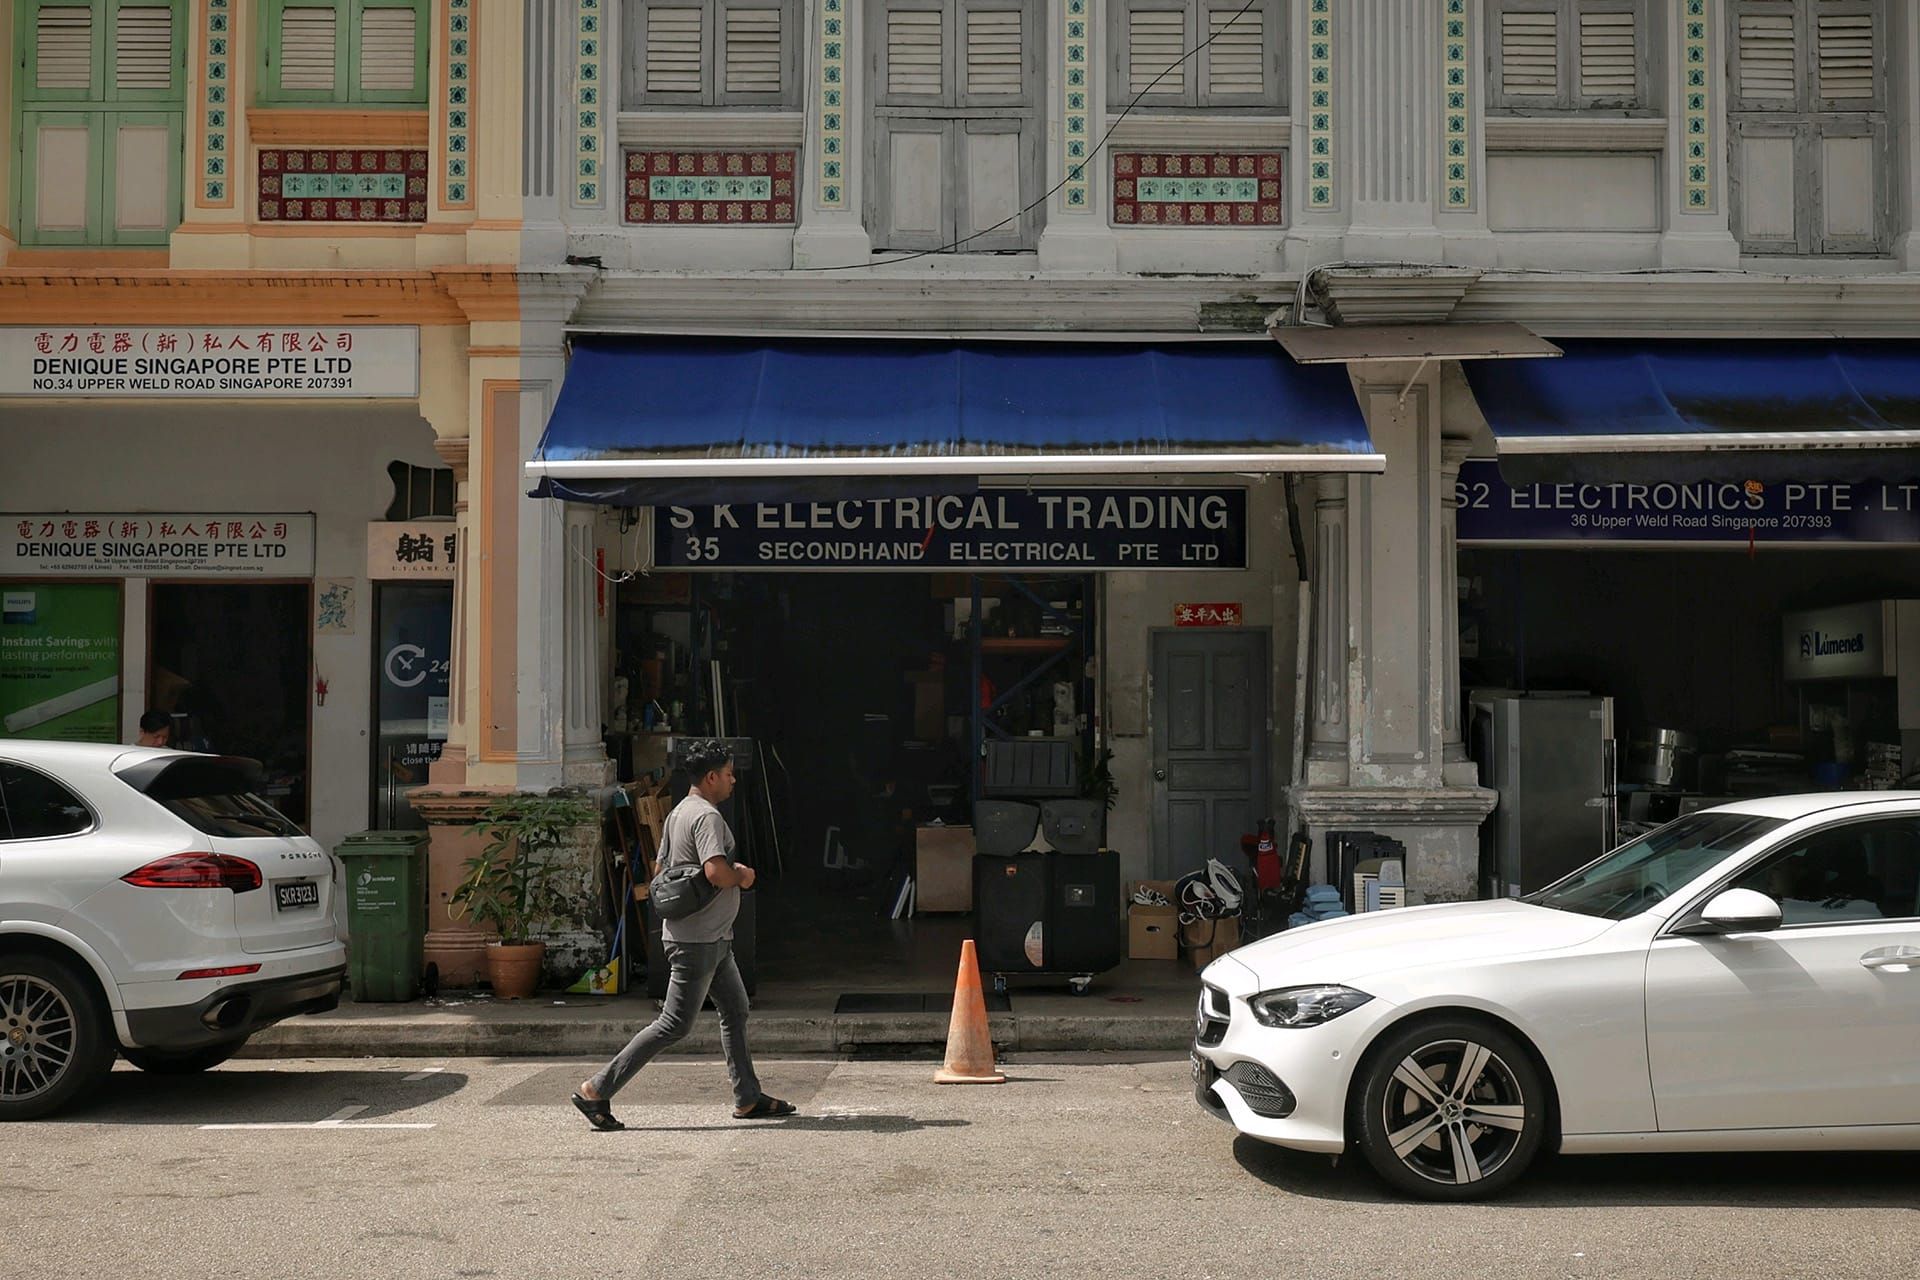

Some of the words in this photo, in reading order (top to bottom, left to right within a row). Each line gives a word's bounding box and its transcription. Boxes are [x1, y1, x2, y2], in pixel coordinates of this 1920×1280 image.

[33, 358, 128, 375] DENIQUE
[134, 358, 260, 375] SINGAPORE
[267, 358, 307, 374] PTE
[314, 358, 352, 374] LTD
[33, 379, 73, 389] NO.34
[78, 379, 125, 389] UPPER
[129, 379, 170, 389] WELD
[175, 379, 215, 389] ROAD
[219, 378, 303, 389] SINGAPORE
[307, 378, 353, 389] 207391
[1510, 482, 1765, 511] ELECTRONICS
[713, 503, 740, 529] K
[756, 496, 1020, 530] ELECTRICAL
[1037, 495, 1229, 530] TRADING
[1571, 514, 1587, 527] 36
[1591, 514, 1631, 529] Upper
[1635, 514, 1669, 527] Weld
[1672, 514, 1708, 528] Road
[1712, 514, 1779, 530] Singapore
[1782, 515, 1832, 528] 207393
[16, 542, 97, 557] DENIQUE
[102, 542, 208, 557] SINGAPORE
[214, 543, 248, 557] PTE
[254, 543, 286, 557] LTD
[685, 537, 719, 560] 35
[758, 541, 924, 560] SECONDHAND
[950, 542, 1095, 561] ELECTRICAL
[1118, 543, 1159, 560] PTE
[1182, 543, 1220, 561] LTD
[2, 636, 43, 646] Instant
[46, 636, 90, 648] Savings
